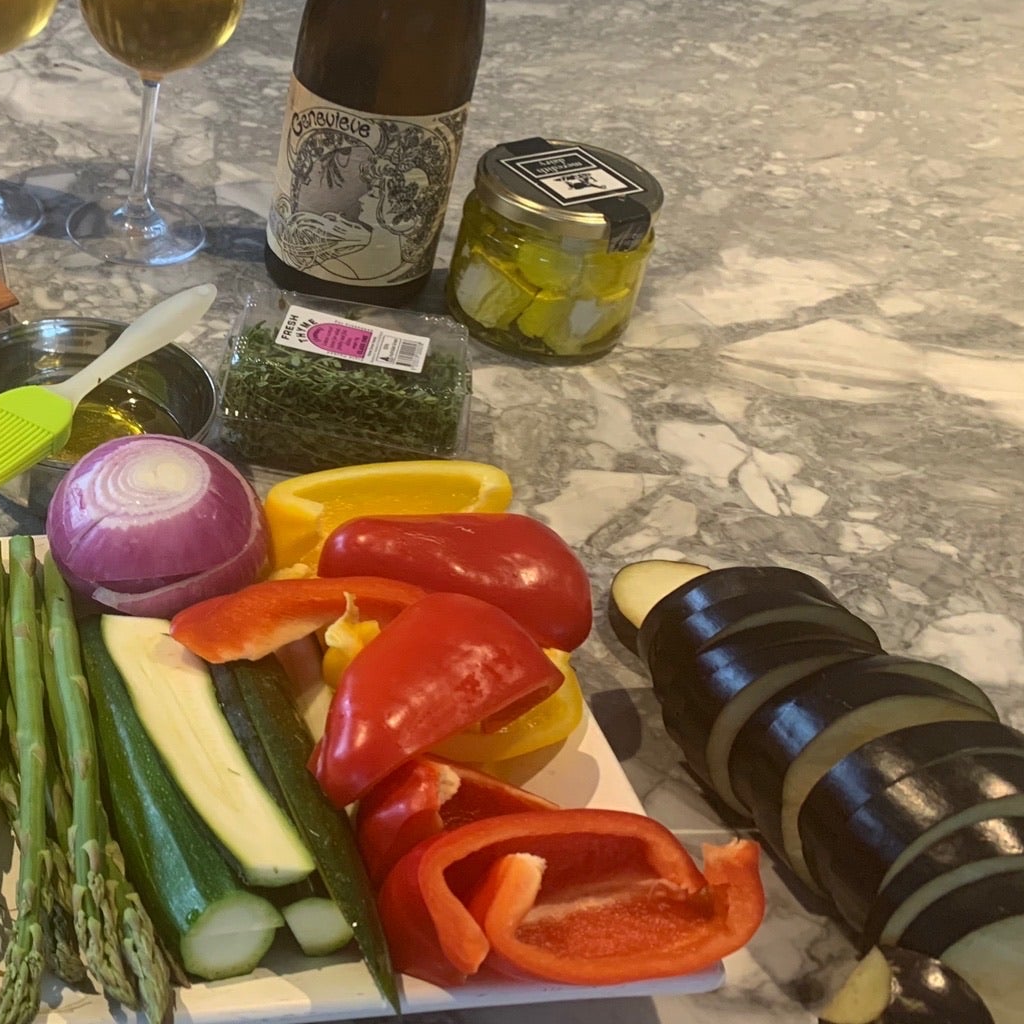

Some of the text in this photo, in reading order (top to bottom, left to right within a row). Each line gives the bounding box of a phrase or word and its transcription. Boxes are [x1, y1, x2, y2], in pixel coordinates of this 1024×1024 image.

[291, 110, 371, 138] Genevieve
[281, 314, 299, 340] FRESH
[296, 318, 318, 343] THYME
